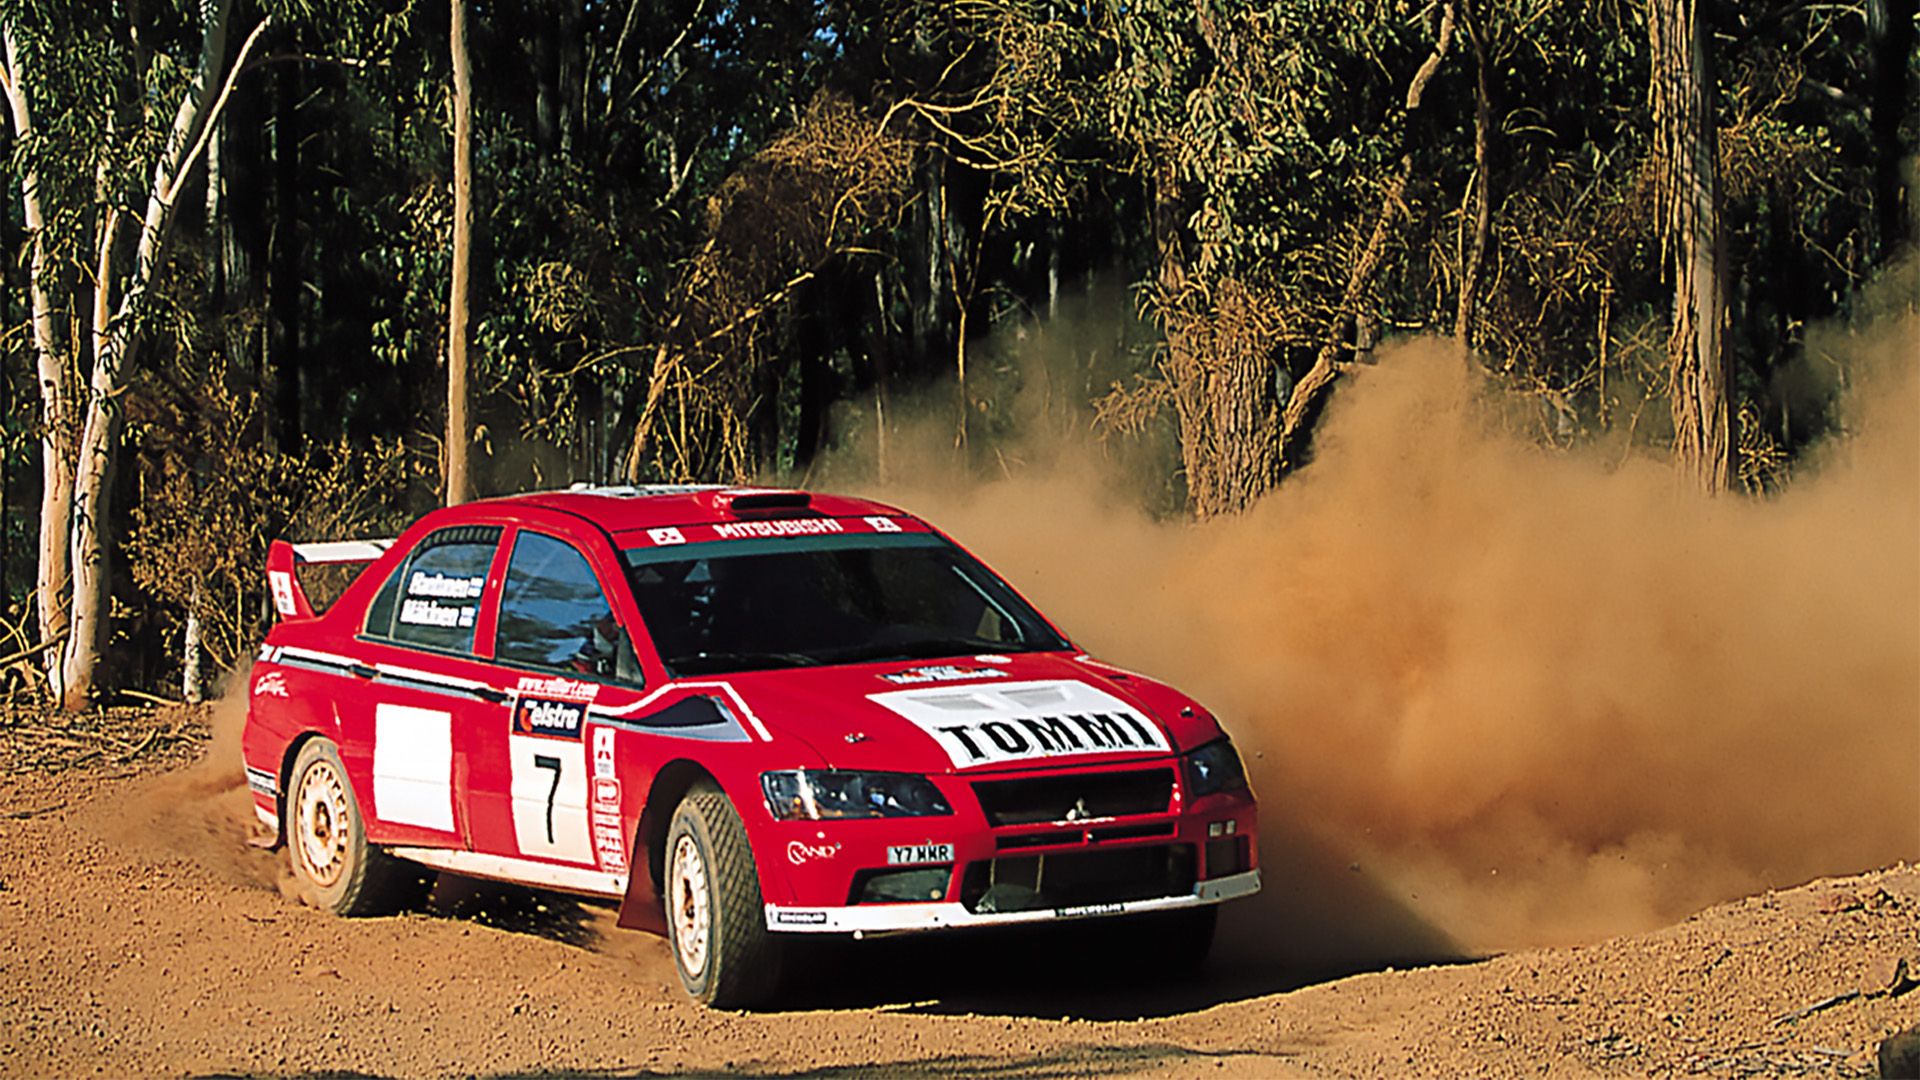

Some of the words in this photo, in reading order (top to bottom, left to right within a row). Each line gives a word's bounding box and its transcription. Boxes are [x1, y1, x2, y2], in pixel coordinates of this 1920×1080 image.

[712, 519, 843, 538] MITSUBISHI
[935, 711, 1160, 763] TOMMI
[534, 754, 562, 844] 7
[893, 847, 912, 862] Y7
